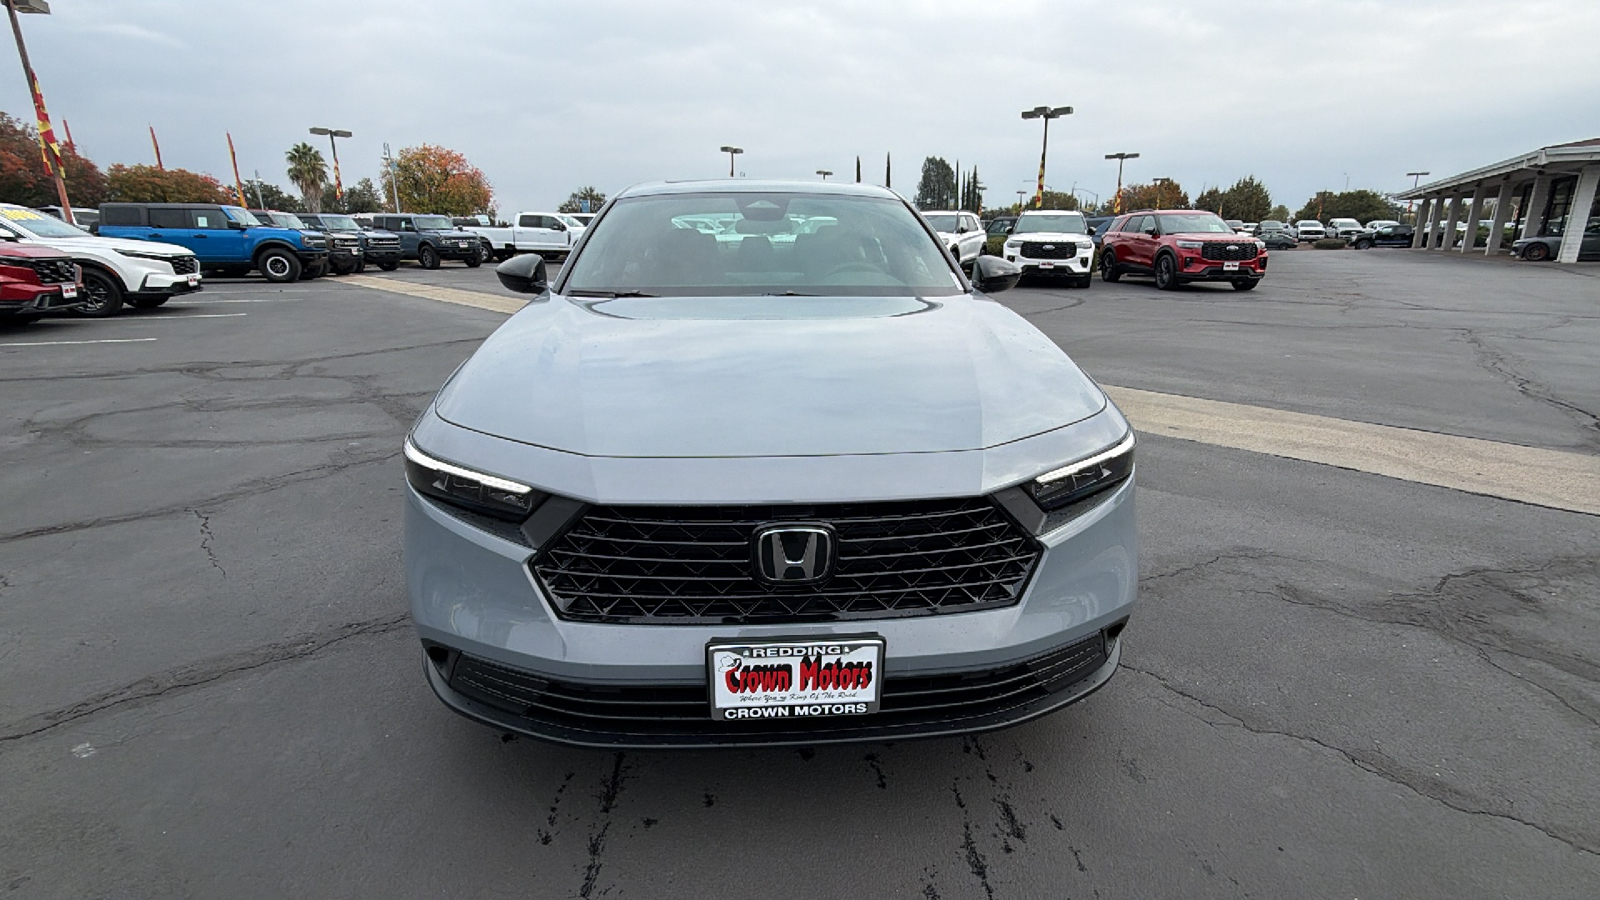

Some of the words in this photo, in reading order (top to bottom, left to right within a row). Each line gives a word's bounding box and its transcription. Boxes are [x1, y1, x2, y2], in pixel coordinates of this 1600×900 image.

[752, 646, 841, 658] REDDING
[725, 658, 793, 694] Crown
[799, 655, 873, 692] Motors
[739, 694, 762, 703] Where
[789, 692, 808, 701] King
[810, 692, 820, 701] Of
[821, 691, 835, 700] The
[725, 706, 789, 720] CROWN
[794, 703, 867, 717] MOTORS
